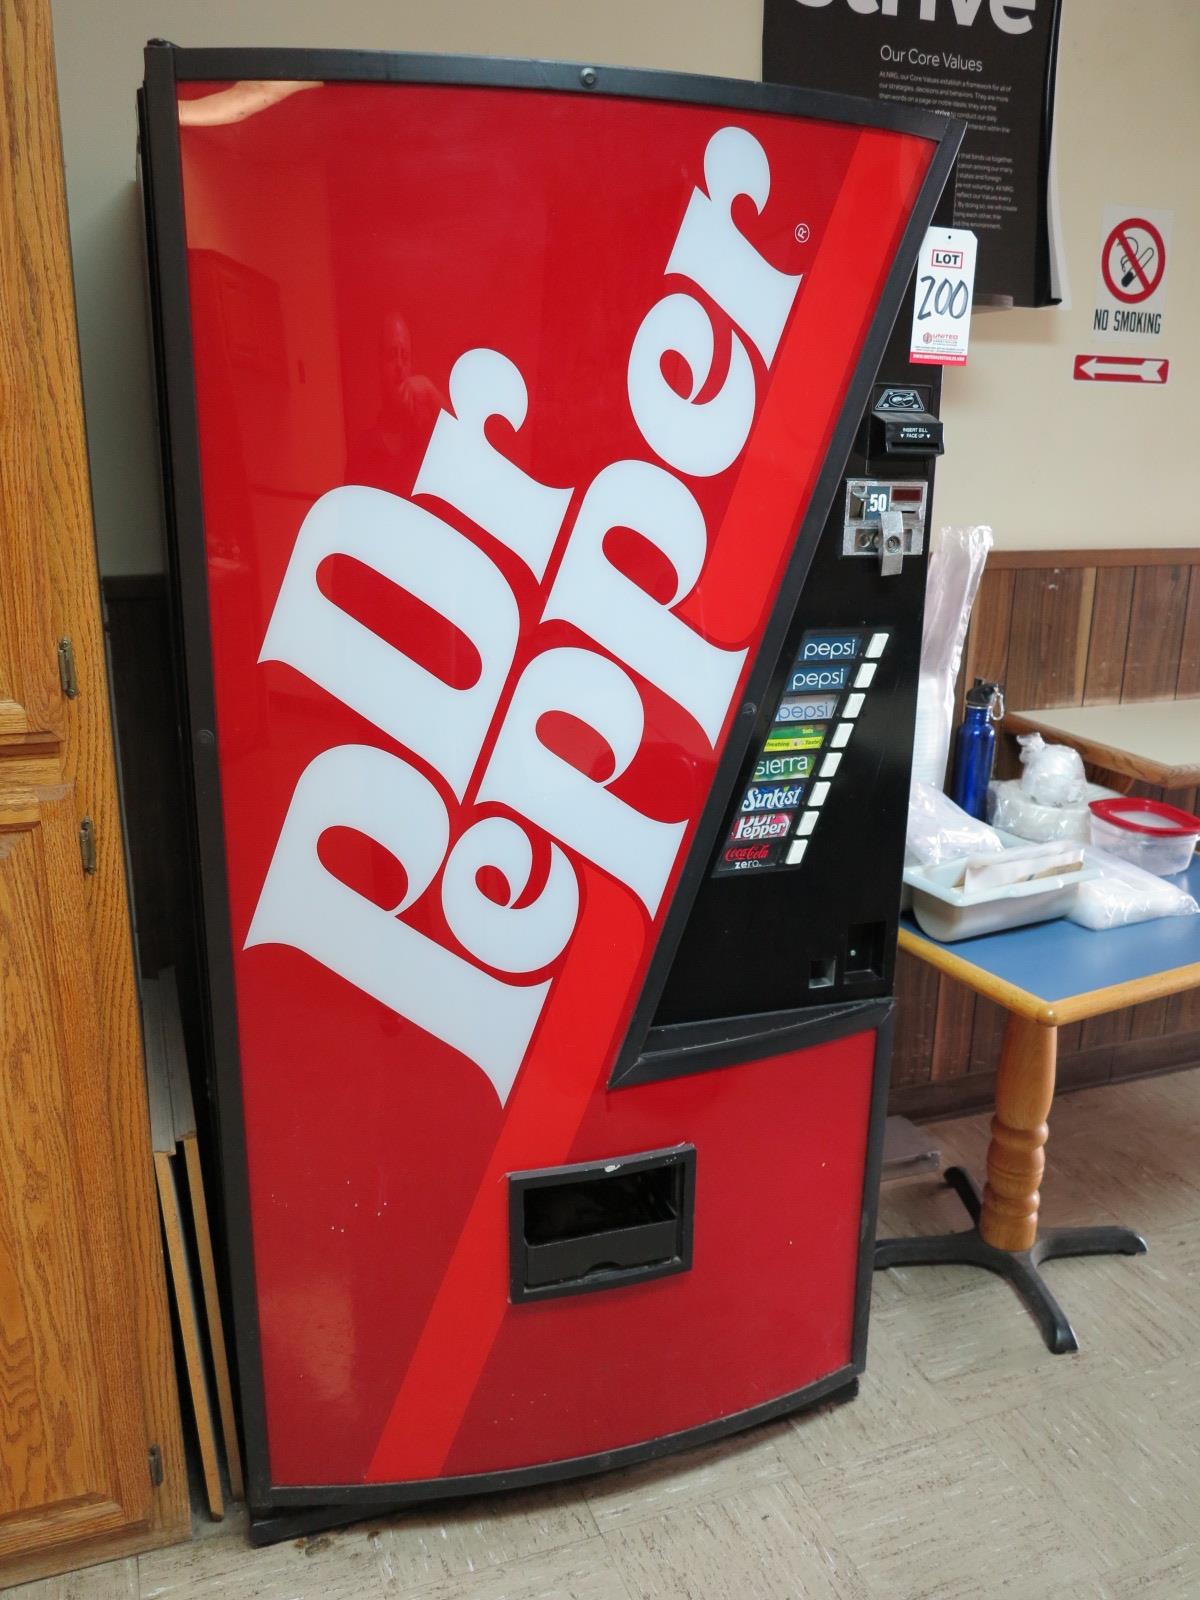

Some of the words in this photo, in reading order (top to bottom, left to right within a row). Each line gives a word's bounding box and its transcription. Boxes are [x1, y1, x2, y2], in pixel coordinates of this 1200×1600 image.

[880, 45, 906, 63] Our
[908, 48, 940, 68] Core
[943, 52, 983, 73] Values
[935, 253, 960, 266] LOT
[917, 275, 969, 320] 200
[1093, 309, 1109, 331] NO
[1113, 310, 1162, 334] SMOKING
[258, 347, 575, 805] Dr
[242, 126, 803, 1109] Pepper
[804, 639, 856, 660] pepsi
[792, 668, 844, 690] pepsi
[778, 702, 829, 720] pepsi
[741, 786, 802, 811] Sunkist
